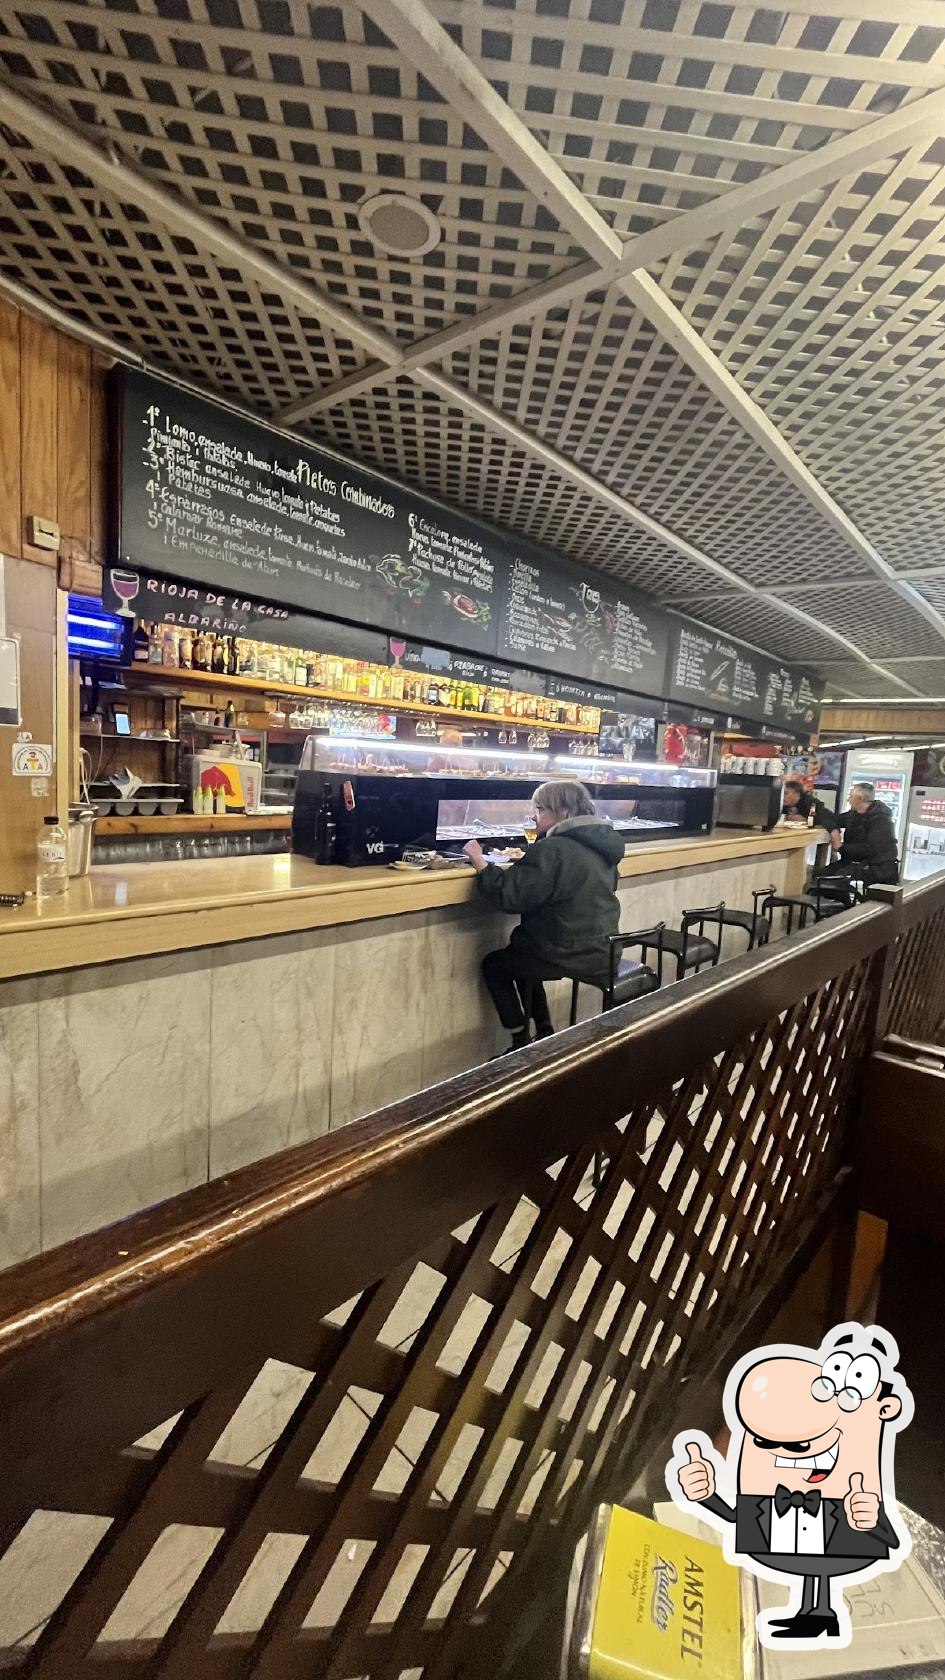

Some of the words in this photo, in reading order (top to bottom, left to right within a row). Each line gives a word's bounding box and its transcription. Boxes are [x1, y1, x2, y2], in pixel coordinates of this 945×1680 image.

[163, 612, 249, 634] ALBARIÑO
[205, 592, 225, 607] DE
[231, 598, 252, 612] LA
[256, 604, 289, 619] CASA
[635, 1584, 647, 1625] NATURAL
[652, 1553, 678, 1632] Radler
[680, 1554, 705, 1663] AMSTEL
